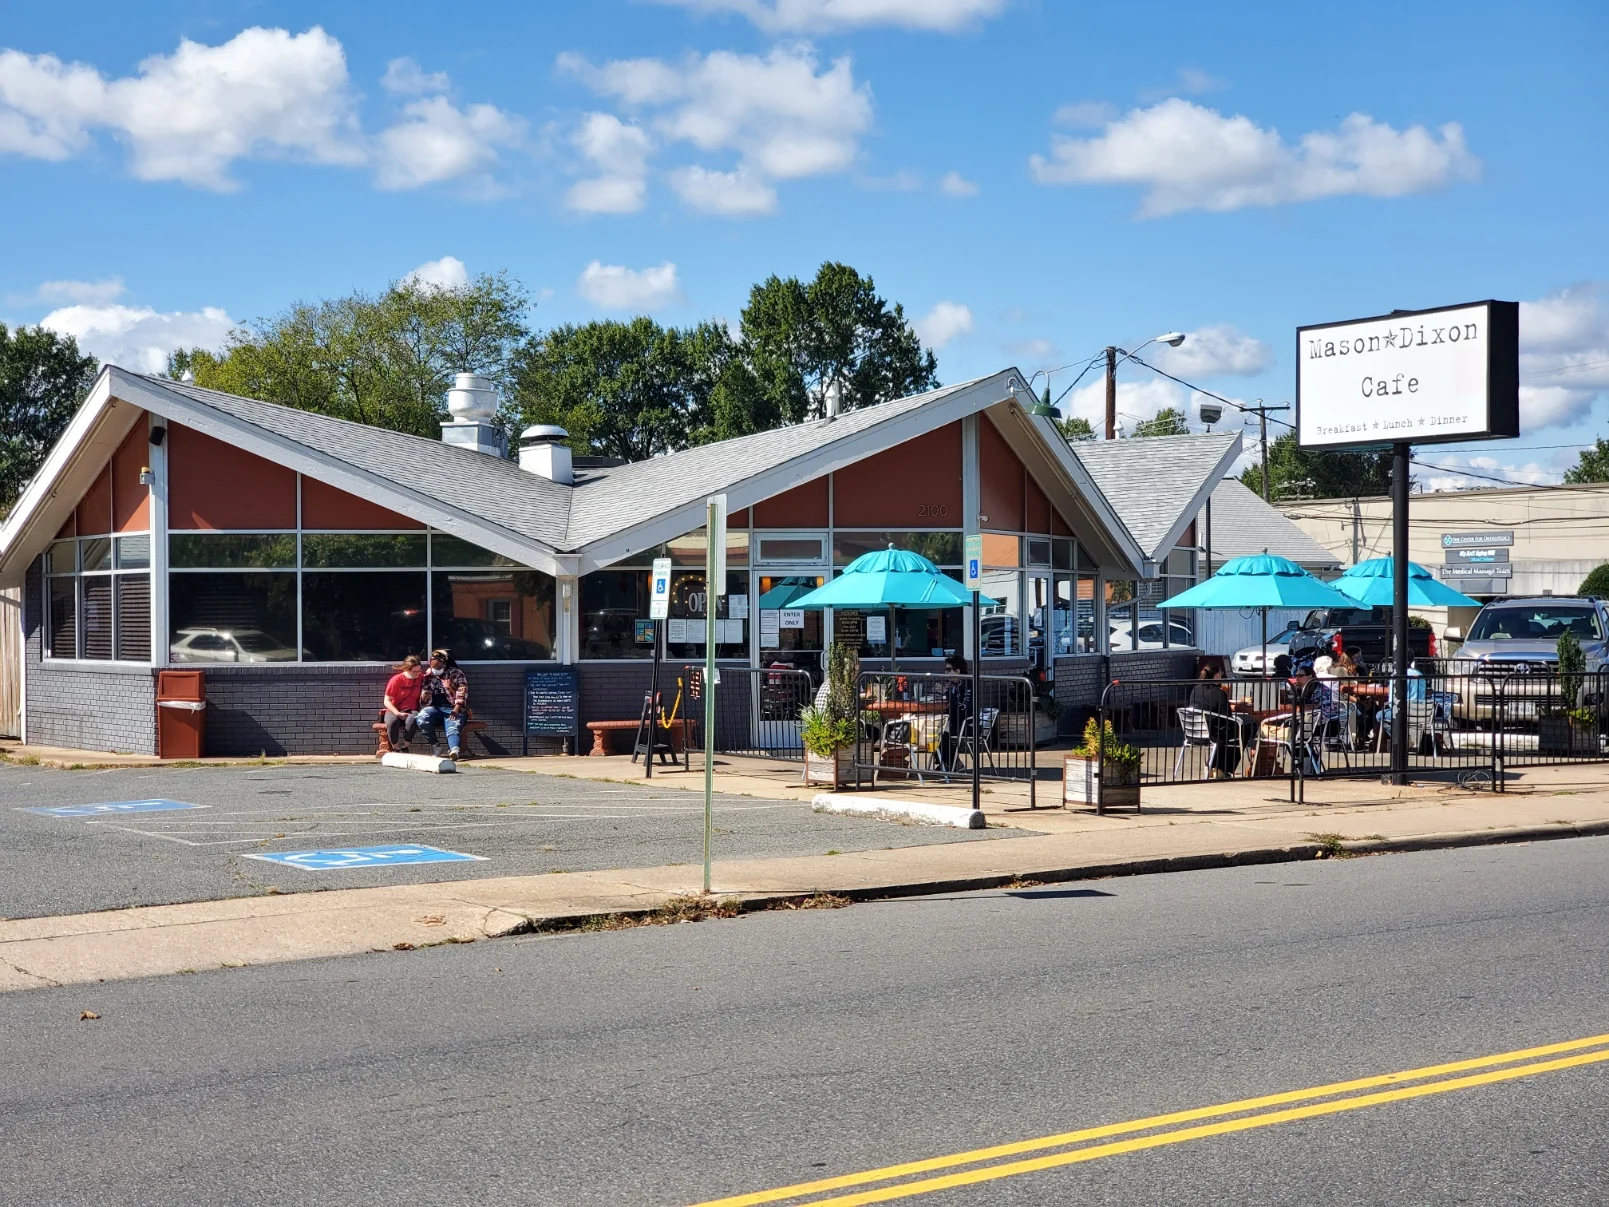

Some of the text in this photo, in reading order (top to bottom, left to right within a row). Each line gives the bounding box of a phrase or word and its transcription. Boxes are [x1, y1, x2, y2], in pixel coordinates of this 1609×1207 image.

[1361, 373, 1419, 398] Cafe
[1317, 415, 1468, 435] Breakfast Lunch Dinner
[918, 505, 948, 516] 2100
[1473, 567, 1496, 576] Massage
